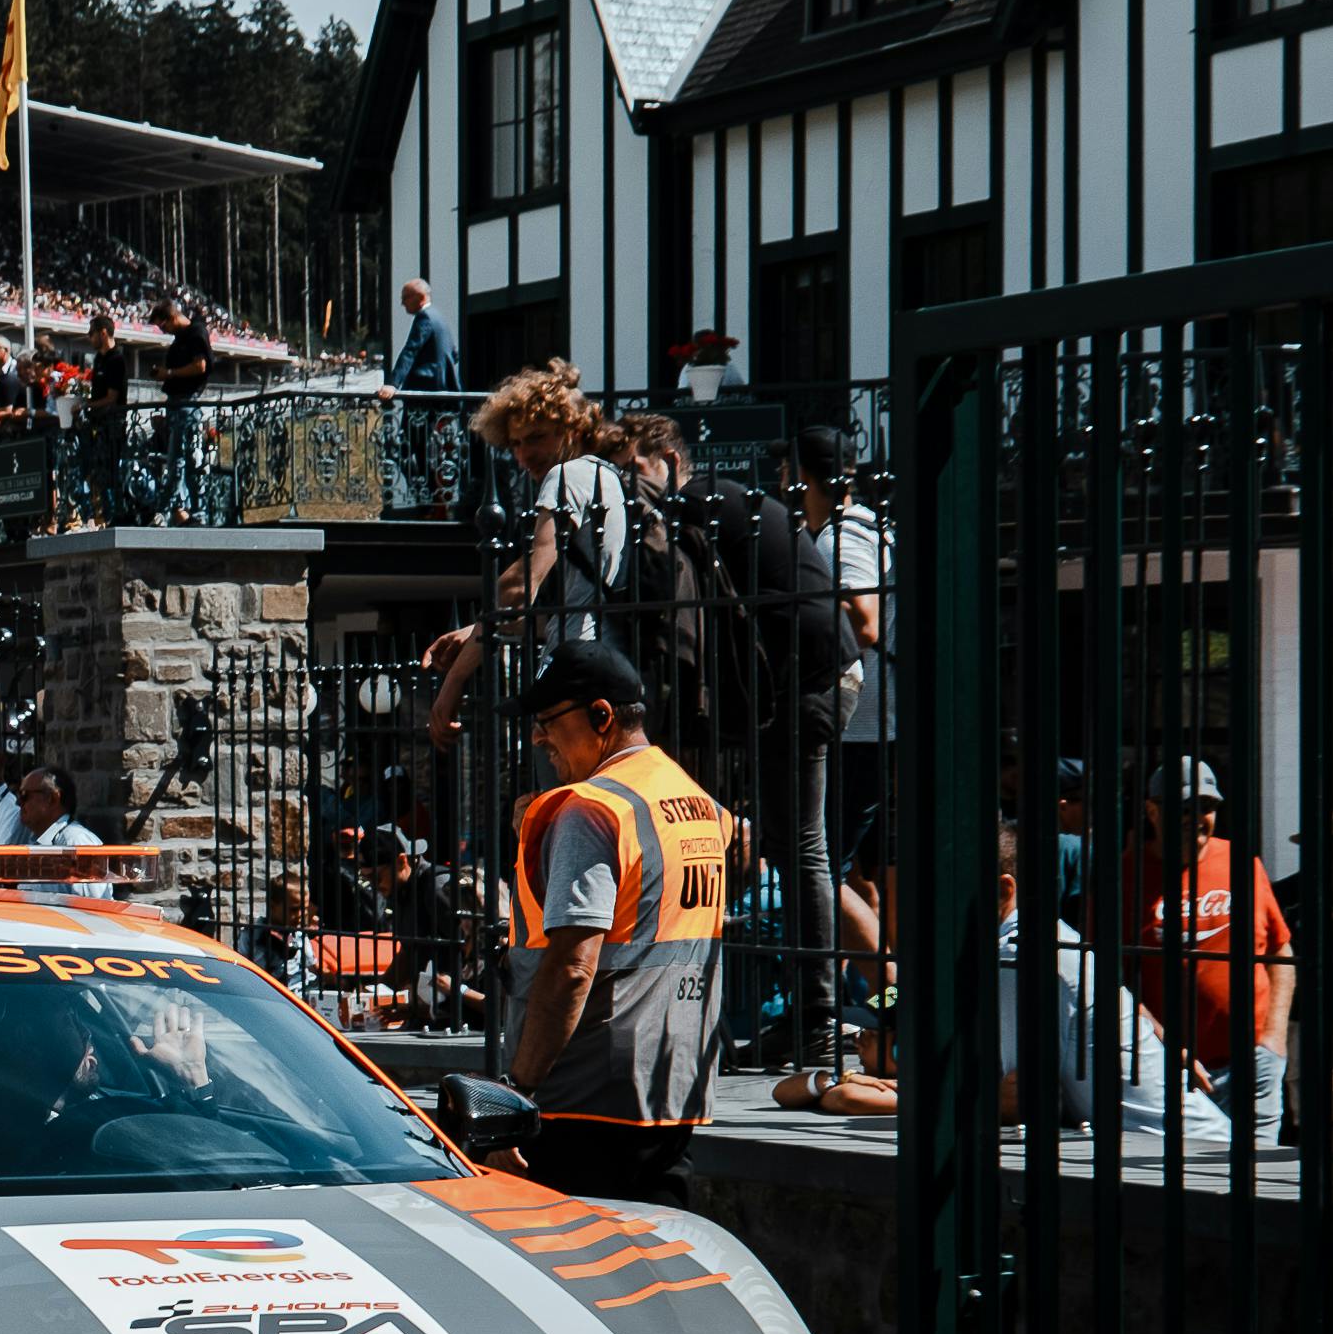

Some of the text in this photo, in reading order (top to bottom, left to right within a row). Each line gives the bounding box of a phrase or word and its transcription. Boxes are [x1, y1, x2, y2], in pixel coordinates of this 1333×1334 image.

[98, 1269, 353, 1288] TotalEnergies
[201, 1302, 400, 1315] 24 HOURS
